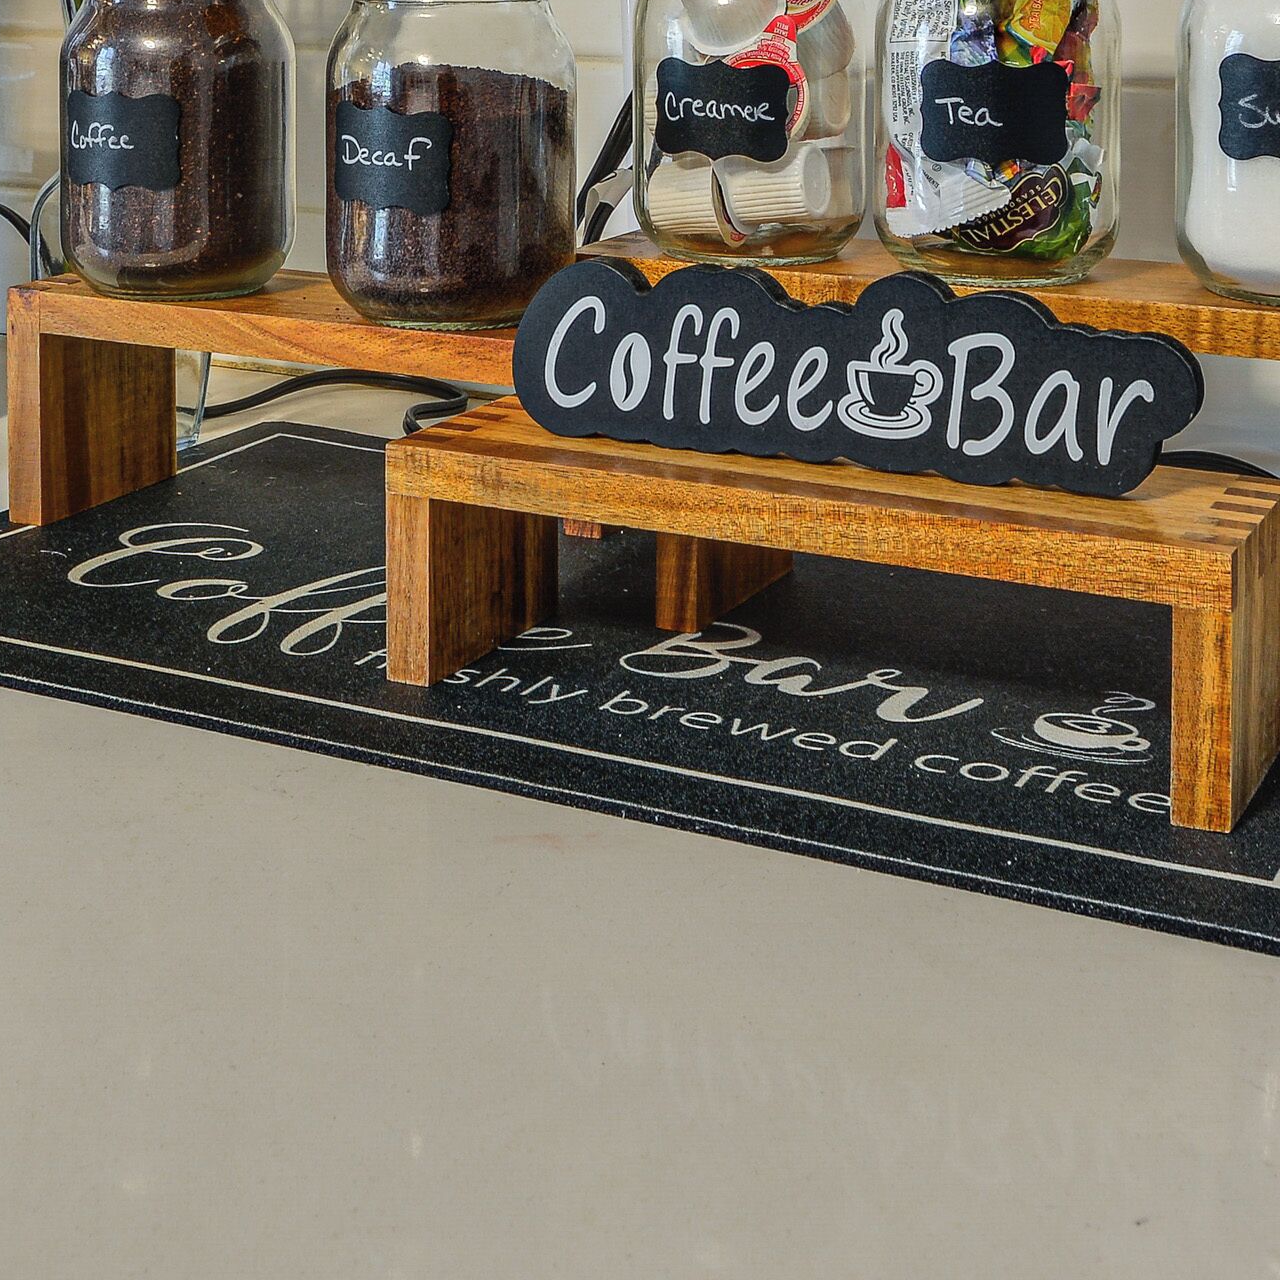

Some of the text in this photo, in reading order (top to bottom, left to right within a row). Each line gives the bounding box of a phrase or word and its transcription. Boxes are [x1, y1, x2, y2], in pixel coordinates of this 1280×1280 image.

[71, 119, 135, 150] Coffee
[934, 97, 1004, 127] Tea
[341, 134, 433, 171] Decaf
[544, 296, 1153, 466] Coffee Bar
[619, 622, 985, 723] Bar
[598, 690, 897, 762] brewed
[913, 765, 1172, 815] coffee
